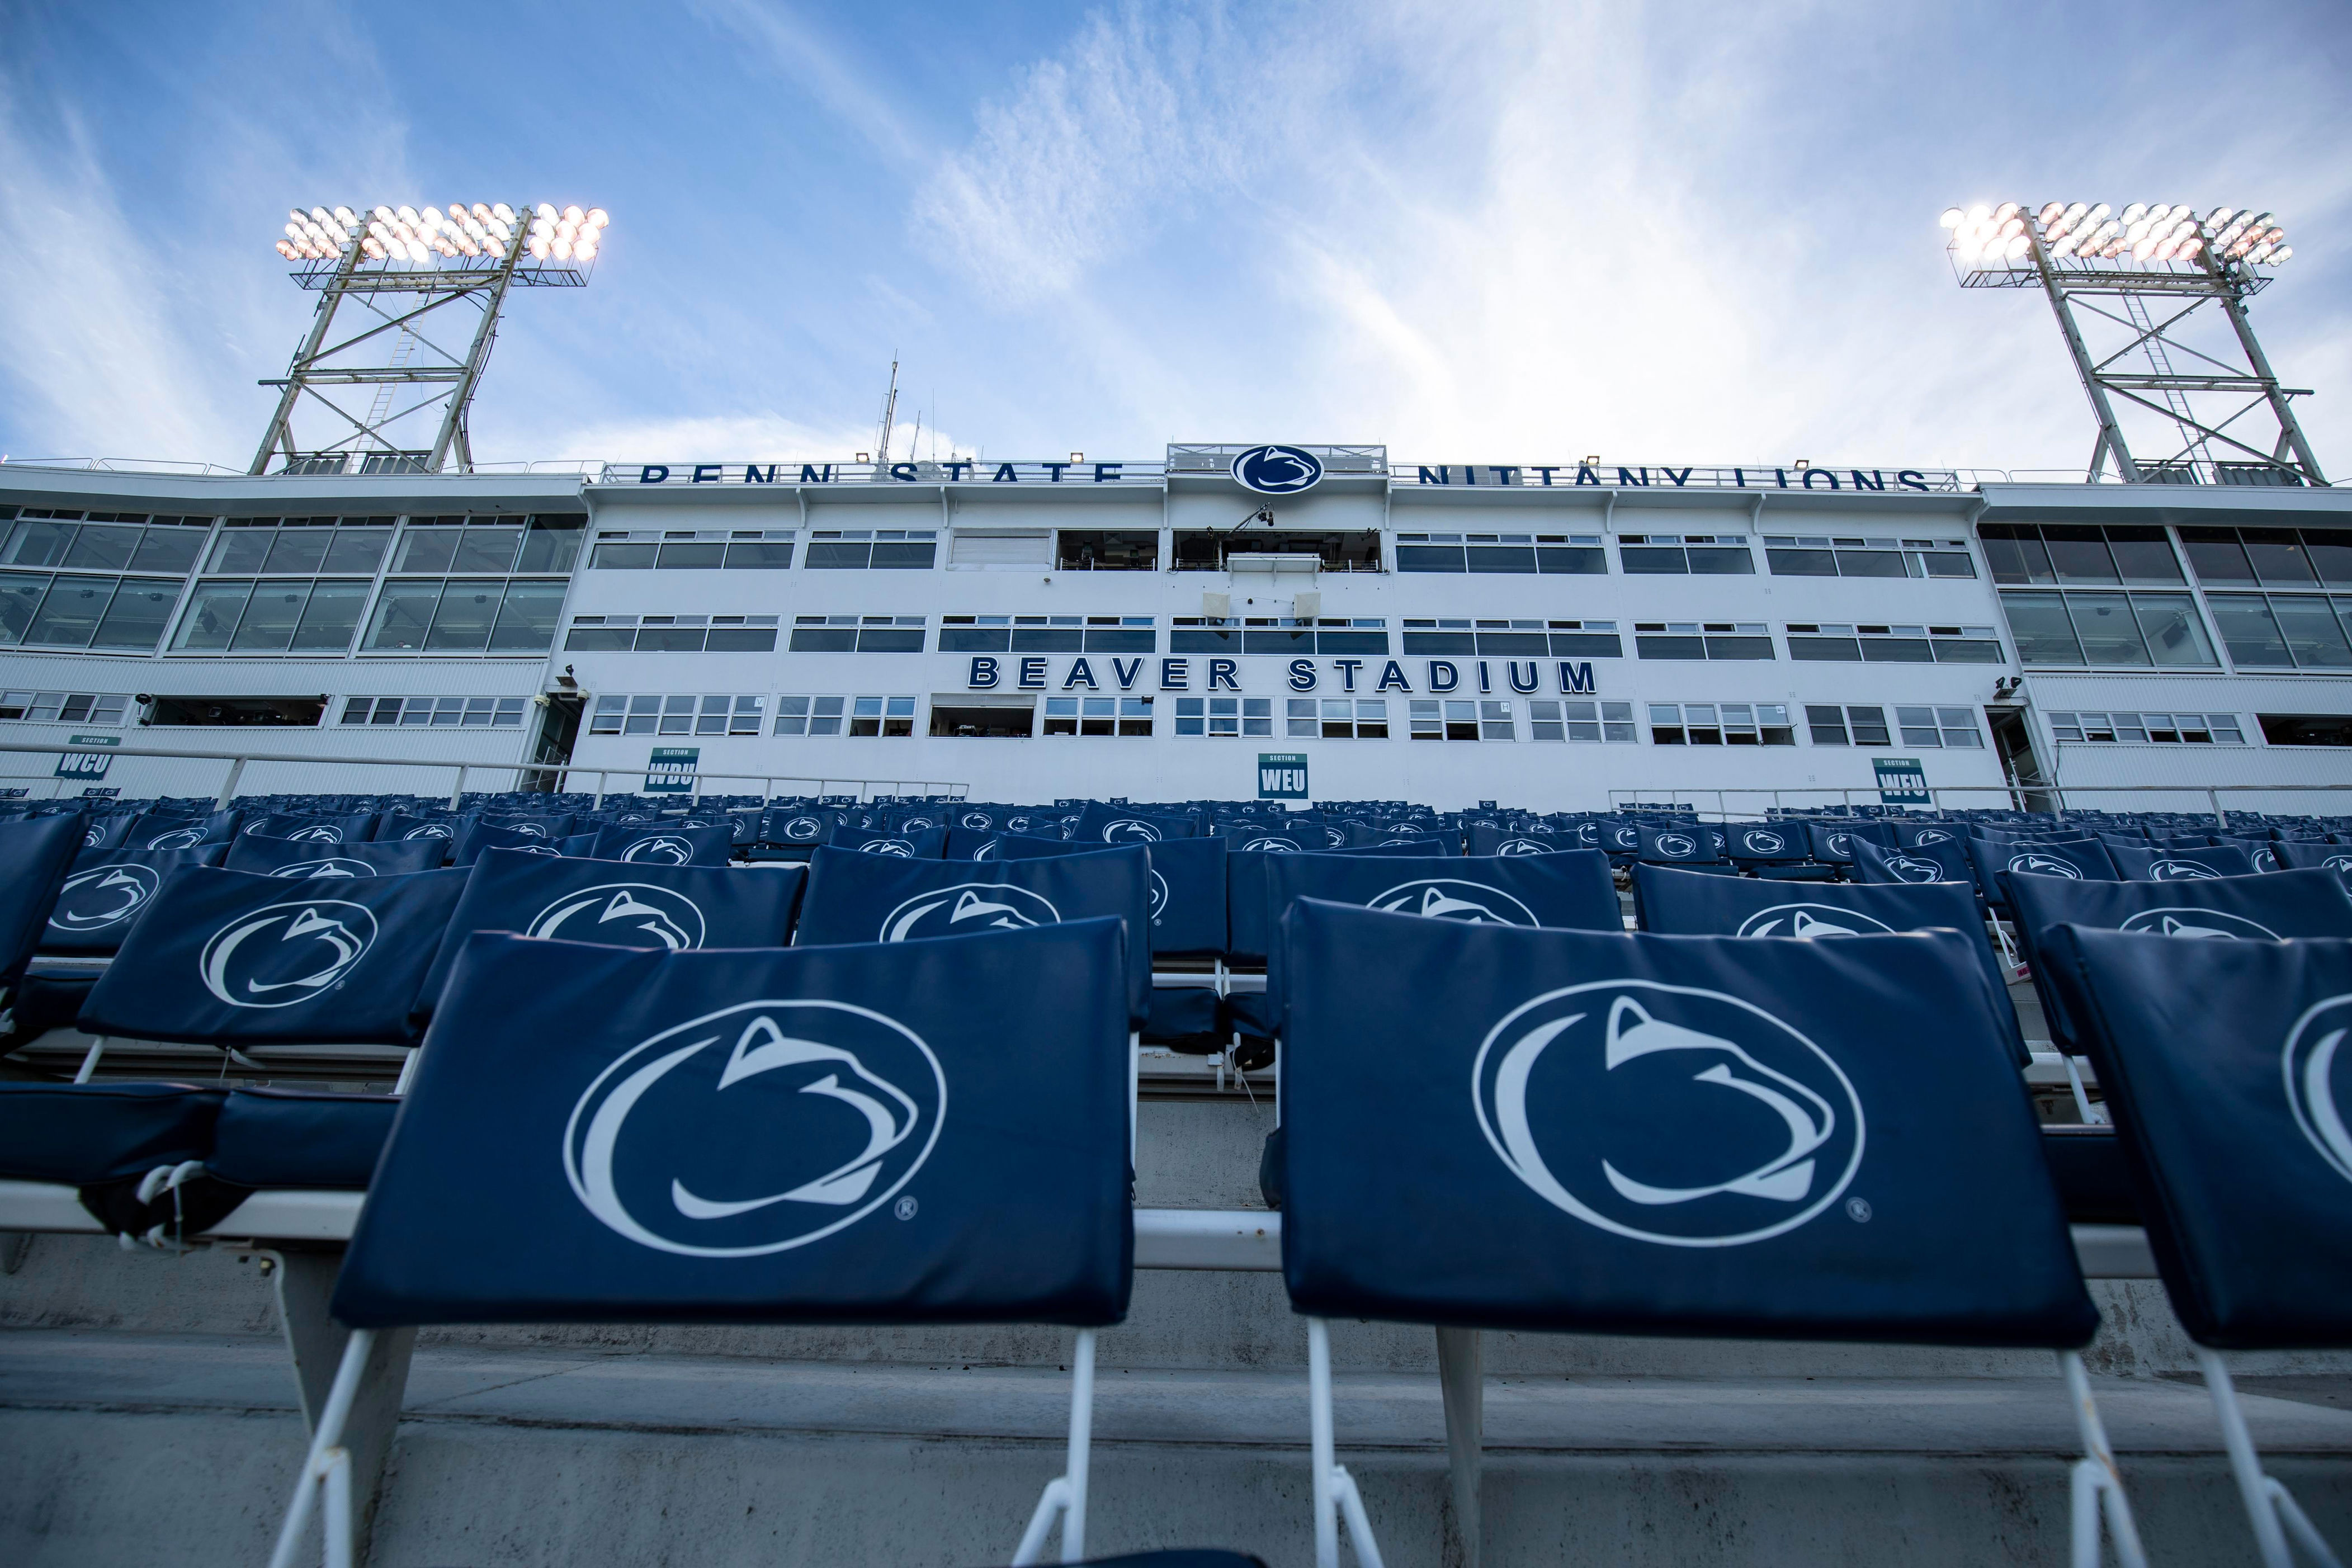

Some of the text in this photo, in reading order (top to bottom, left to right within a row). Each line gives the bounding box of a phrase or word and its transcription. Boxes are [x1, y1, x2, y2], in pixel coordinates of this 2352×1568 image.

[967, 656, 1597, 693] BEAVER STADIUM
[60, 753, 112, 773] WCU
[648, 763, 696, 785] WDU
[1261, 769, 1305, 792] WEU
[1878, 773, 1925, 797] WFU
